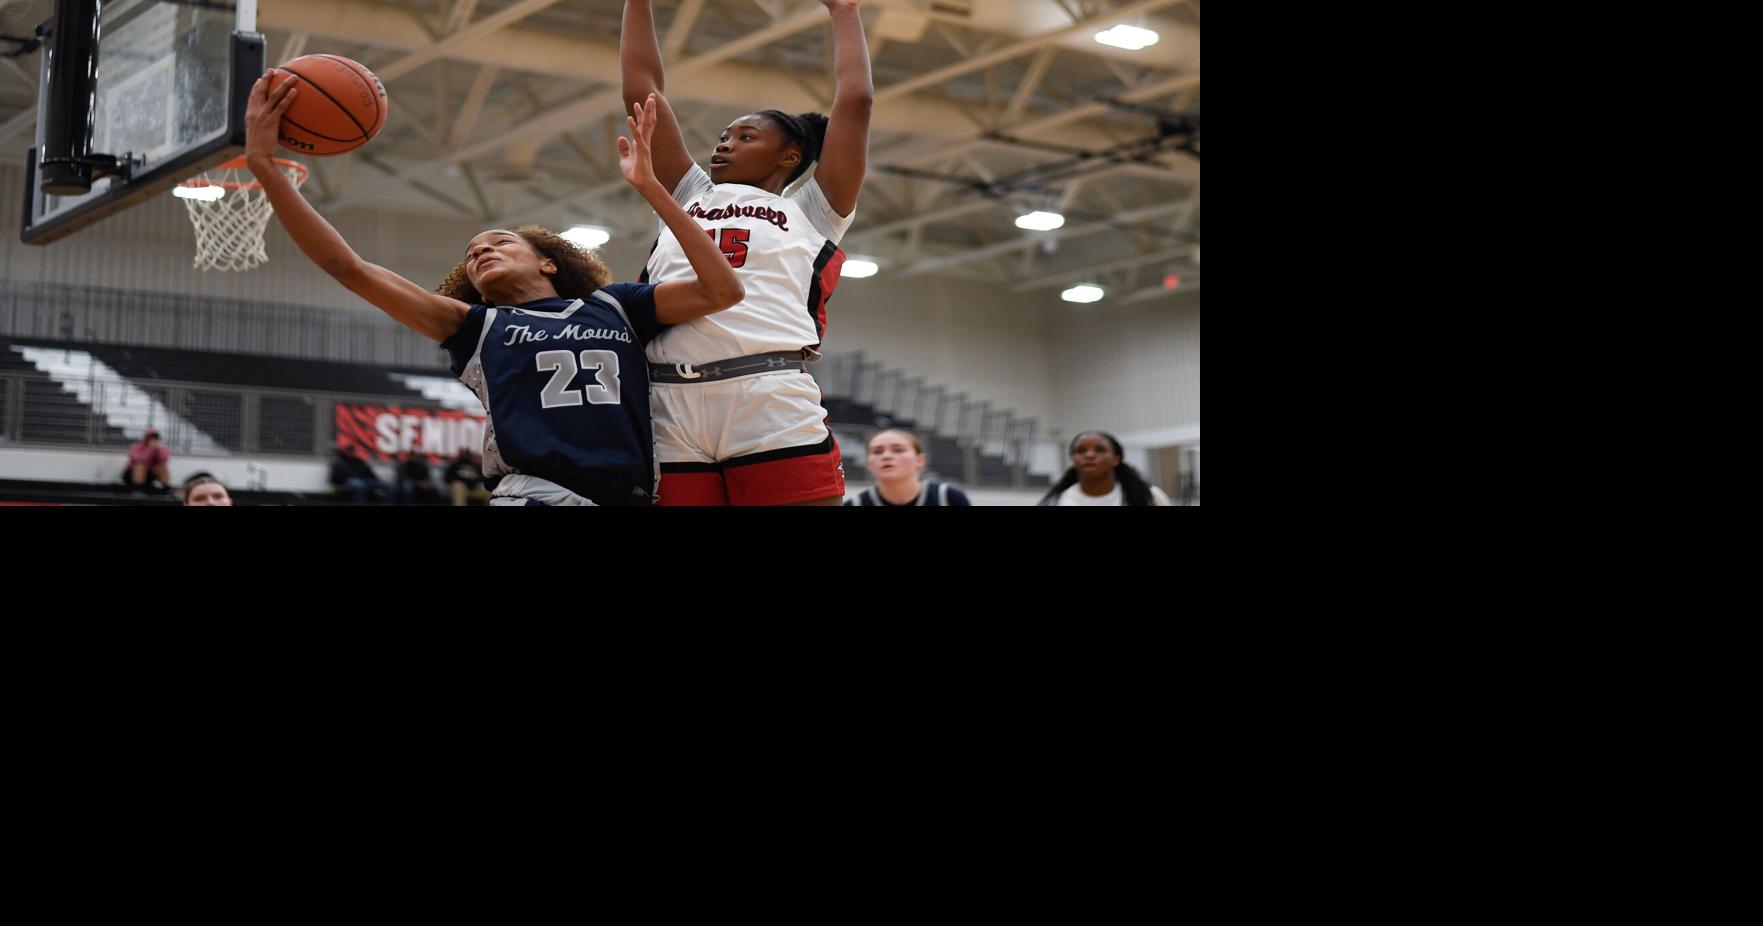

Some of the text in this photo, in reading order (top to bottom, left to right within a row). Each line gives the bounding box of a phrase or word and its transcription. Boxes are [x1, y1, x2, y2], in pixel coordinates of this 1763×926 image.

[503, 323, 632, 347] The Mound
[535, 349, 621, 409] 23
